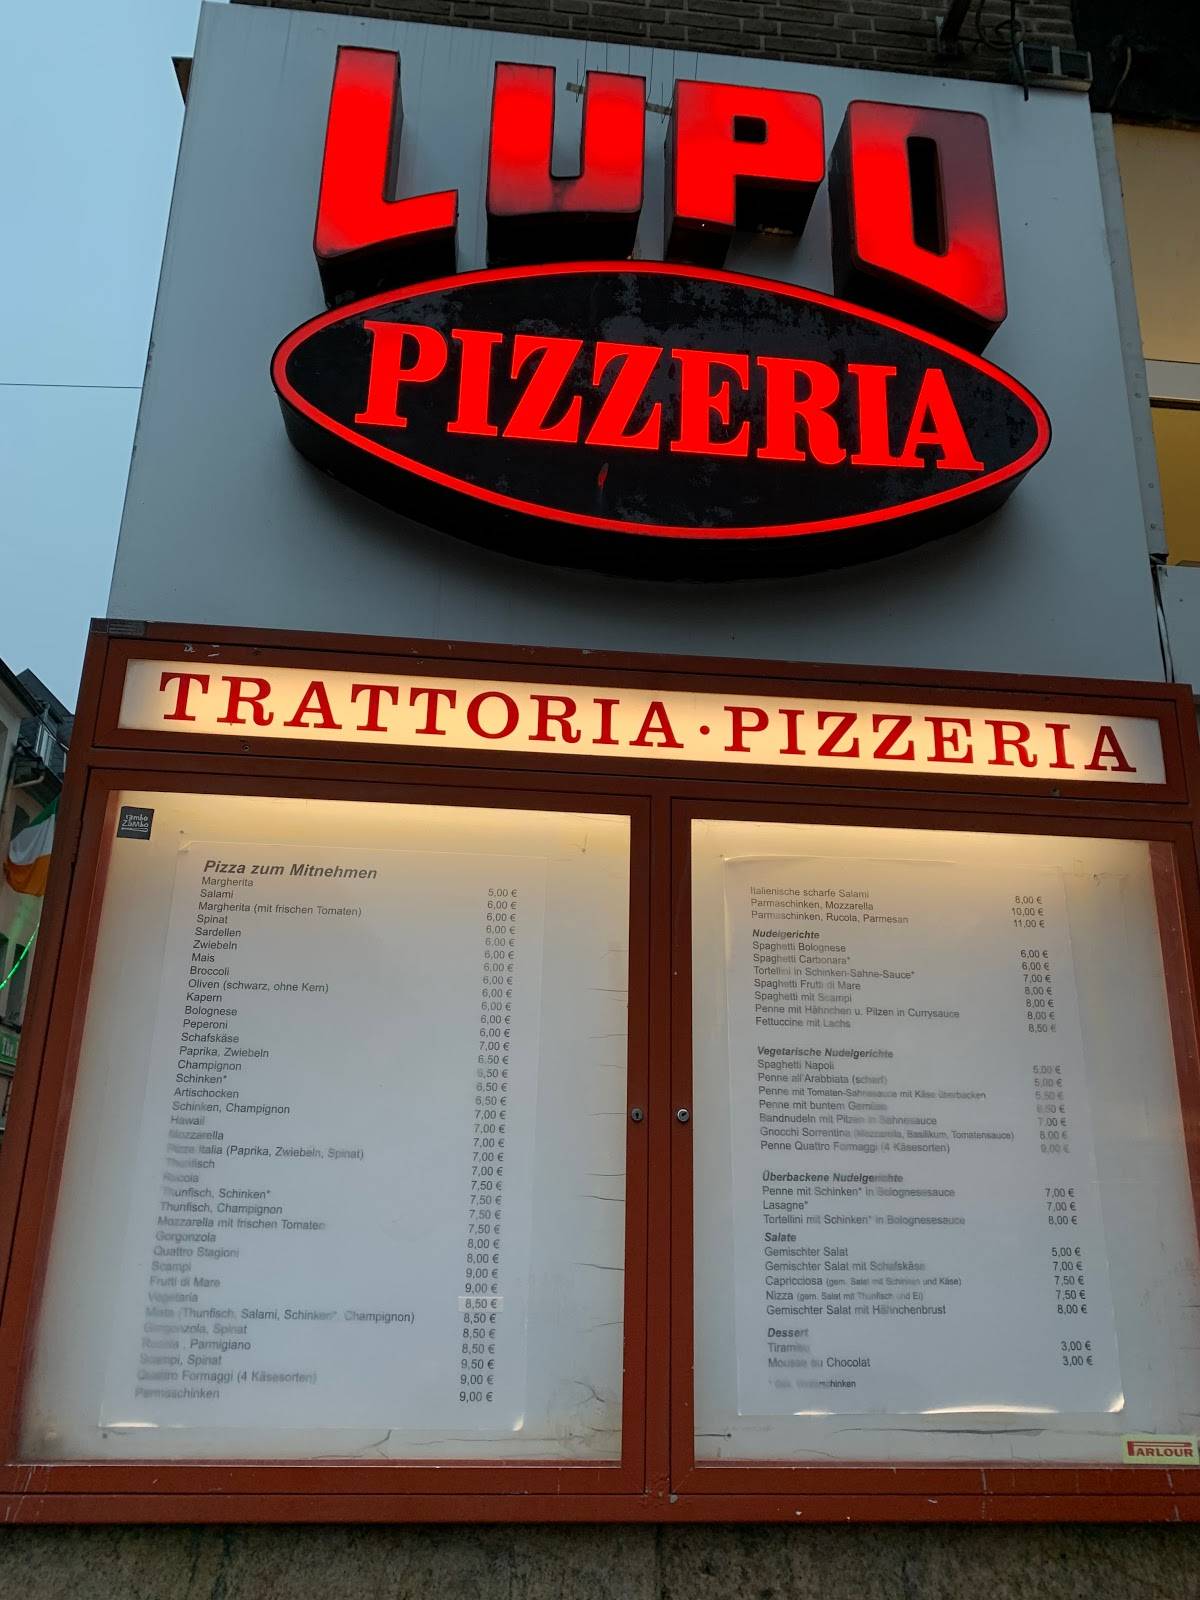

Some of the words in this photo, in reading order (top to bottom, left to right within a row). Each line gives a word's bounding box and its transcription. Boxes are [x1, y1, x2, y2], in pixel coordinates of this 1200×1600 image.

[315, 45, 1008, 322] LUPO
[354, 318, 986, 474] PIZZERIA
[160, 673, 684, 747] TRATTORIA
[723, 705, 1137, 773] PIZZERIA
[203, 860, 246, 874] Pizza
[250, 865, 285, 875] zum
[289, 863, 377, 879] Mitnehmen
[201, 876, 254, 888] Margherita
[200, 888, 234, 899] Salami
[487, 888, 509, 898] 5,00
[510, 888, 518, 898] €
[802, 888, 836, 898] scharfe
[838, 889, 869, 899] Salami
[198, 901, 251, 913] Margherita
[253, 903, 273, 914] (mit
[275, 904, 313, 914] frischen
[316, 905, 362, 918] Tomaten)
[487, 900, 508, 910] 6,00
[510, 901, 517, 910] €
[825, 900, 874, 911] Mozzarella
[486, 912, 507, 923] 6,00
[509, 913, 516, 922] €
[826, 912, 860, 923] Rucola,
[862, 913, 909, 924] Parmesan
[1011, 907, 1036, 917] 10,00
[1037, 907, 1044, 916] €
[196, 913, 228, 925] Spinat
[1013, 919, 1037, 928] 11,00
[1039, 919, 1045, 928] €
[194, 926, 242, 937] Sardellen
[752, 929, 820, 940] Nudelgerichte
[192, 939, 238, 950] Zwiebeln
[798, 942, 846, 954] Bolognese
[191, 952, 215, 963] Mais
[484, 950, 506, 960] 6,00
[507, 950, 514, 960] €
[1020, 949, 1040, 959] 6,00
[1042, 950, 1049, 959] €
[189, 965, 230, 976] Broccoli
[793, 966, 803, 976] in
[1021, 961, 1042, 971] 6,00
[1043, 962, 1050, 971] €
[754, 978, 798, 990] Spaghetti
[837, 980, 861, 991] Mare
[1023, 973, 1043, 984] 7,00
[1044, 974, 1052, 983] €
[188, 978, 220, 989] Oliven
[223, 980, 270, 991] (schwarz,
[273, 981, 299, 992] ohne
[301, 982, 329, 994] Kern)
[186, 992, 222, 1004] Kapern
[482, 988, 503, 999] 6,00
[505, 988, 513, 998] €
[754, 990, 798, 1003] Spaghetti
[800, 992, 815, 1002] mit
[184, 1005, 238, 1018] Bolognese
[755, 1003, 785, 1014] Penne
[866, 1006, 894, 1017] Pilzen
[896, 1007, 906, 1017] in
[907, 1007, 960, 1019] Currysauce
[183, 1018, 228, 1031] Peperoni
[755, 1016, 804, 1027] Fettuccine
[181, 1032, 239, 1043] Schafskäse
[479, 1027, 501, 1038] 6,00
[503, 1028, 511, 1038] €
[179, 1045, 220, 1058] Paprika,
[223, 1047, 269, 1058] Zwiebeln
[479, 1041, 501, 1052] 7,00
[502, 1041, 510, 1051] €
[757, 1046, 822, 1058] Vegetarische
[824, 1047, 894, 1060] Nudelgerichte
[177, 1059, 242, 1073] Champignon
[757, 1059, 802, 1071] Spaghetti
[804, 1060, 835, 1072] Napoli
[173, 1087, 239, 1099] Artischocken
[172, 1100, 222, 1113] Schinken,
[225, 1102, 290, 1116] Champignon
[759, 1099, 790, 1109] Penne
[792, 1100, 807, 1110] mit
[809, 1100, 845, 1111] buntem
[474, 1109, 497, 1120] 7,00
[499, 1110, 506, 1120] €
[759, 1126, 800, 1137] Gnocchi
[226, 1145, 272, 1158] (Paprika,
[760, 1140, 792, 1150] Penne
[794, 1140, 830, 1151] Quattro
[471, 1165, 494, 1177] 7,00
[496, 1166, 503, 1177] €
[762, 1170, 830, 1182] Überbackene
[471, 1180, 493, 1191] 7,50
[495, 1180, 502, 1191] €
[1045, 1187, 1066, 1199] 7,00
[1068, 1188, 1075, 1198] €
[216, 1202, 283, 1217] Champignon
[1046, 1201, 1068, 1212] 7,00
[1069, 1201, 1076, 1211] €
[763, 1213, 803, 1224] Tortellini
[1048, 1215, 1069, 1226] 8,00
[1071, 1215, 1078, 1225] €
[764, 1232, 797, 1242] Salate
[467, 1238, 490, 1250] 8,00
[492, 1238, 500, 1250] €
[764, 1246, 820, 1257] Gemischter
[823, 1246, 849, 1257] Salat
[1051, 1247, 1072, 1258] 5,00
[1074, 1247, 1081, 1257] €
[765, 1260, 822, 1272] Gemischter
[824, 1260, 849, 1271] Salat
[1052, 1261, 1074, 1272] 7,00
[1075, 1261, 1083, 1271] €
[465, 1267, 489, 1279] 9,00
[491, 1268, 499, 1279] €
[765, 1275, 823, 1288] Capricciosa
[1054, 1275, 1075, 1287] 7,50
[1077, 1275, 1085, 1286] €
[765, 1290, 794, 1301] Nizza
[1055, 1289, 1077, 1301] 7,50
[1078, 1289, 1086, 1300] €
[465, 1298, 488, 1310] 8,50
[490, 1298, 497, 1309] €
[766, 1304, 824, 1315] Gemischter
[826, 1304, 851, 1315] Salat
[1057, 1303, 1079, 1315] 8,00
[1080, 1304, 1087, 1314] €
[241, 1308, 280, 1321] Salami,
[463, 1312, 487, 1325] 8,50
[489, 1313, 497, 1324] €
[767, 1327, 808, 1338] Dessert
[1061, 1340, 1083, 1352] 3,00
[1084, 1340, 1091, 1351] €
[826, 1356, 871, 1368] Chocolat
[1062, 1355, 1084, 1367] 3,00
[1086, 1355, 1093, 1366] €
[460, 1374, 484, 1386] 9,00
[486, 1374, 494, 1385] €
[1127, 1440, 1193, 1457] PARLOUR
